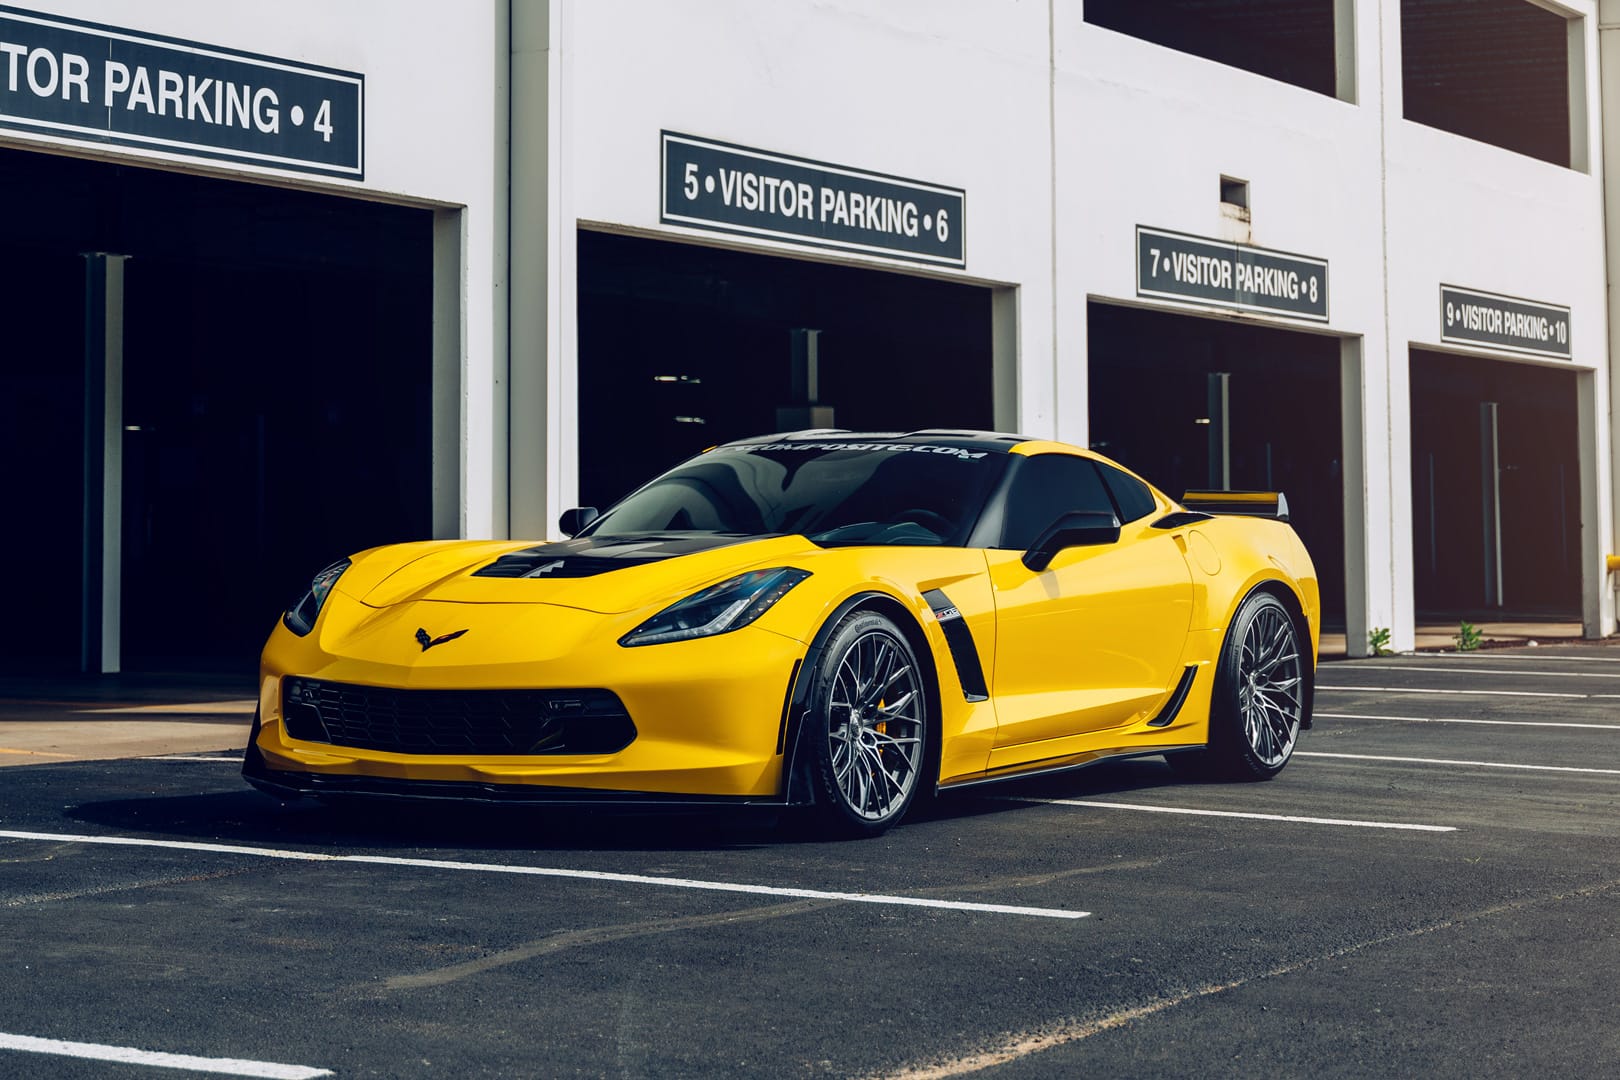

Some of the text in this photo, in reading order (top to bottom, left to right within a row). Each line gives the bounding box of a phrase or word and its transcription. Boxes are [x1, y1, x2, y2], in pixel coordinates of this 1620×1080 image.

[0, 41, 334, 143] TOR PARKING 4
[684, 162, 949, 243] 5 VISITOR PARKING 6
[1150, 248, 1319, 304] 7 VISITOR PARKING 8
[1446, 302, 1567, 345] 9 VISITOR PARKING 10
